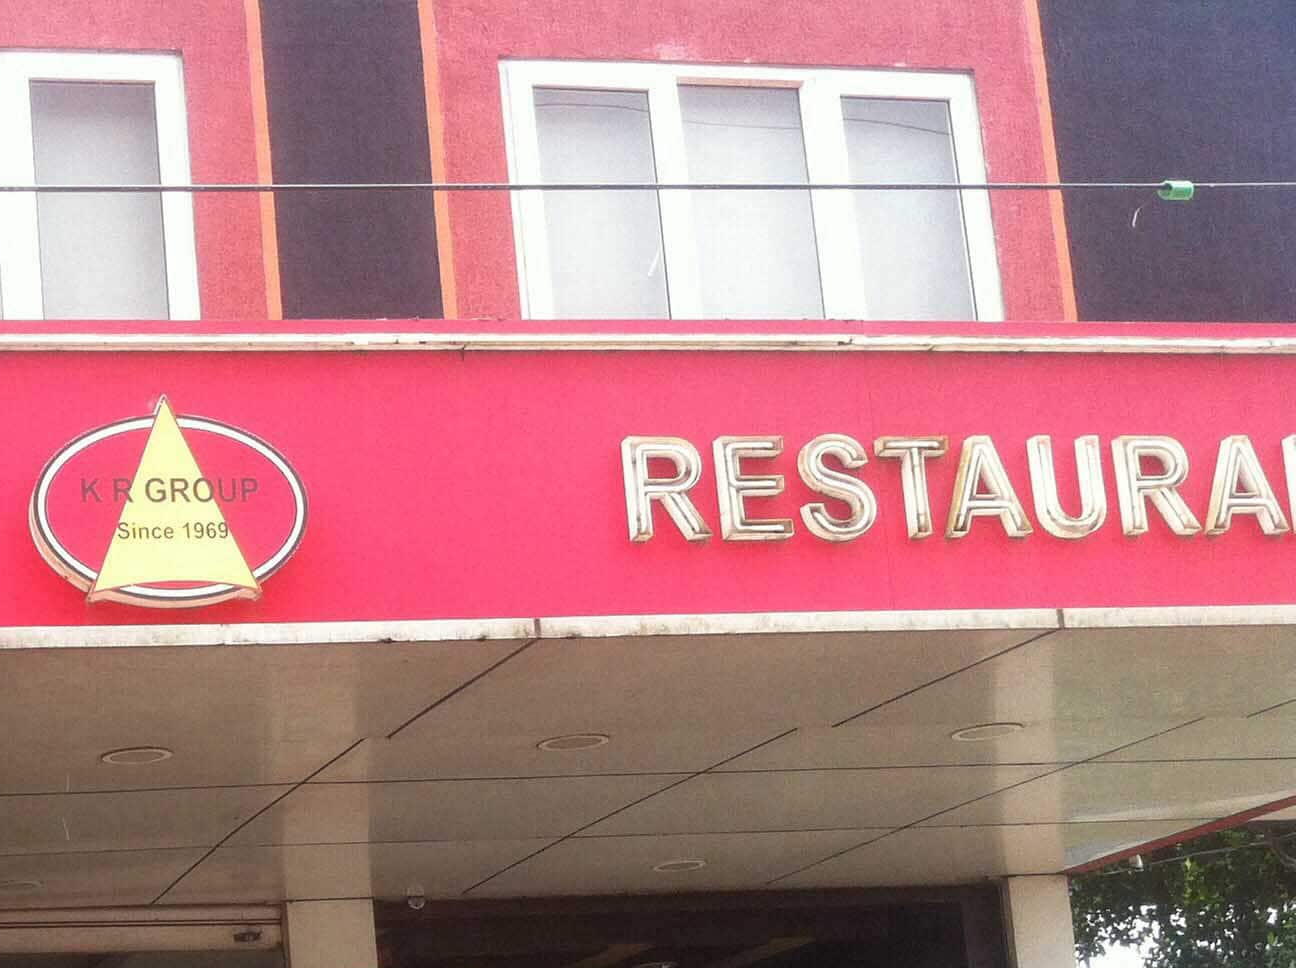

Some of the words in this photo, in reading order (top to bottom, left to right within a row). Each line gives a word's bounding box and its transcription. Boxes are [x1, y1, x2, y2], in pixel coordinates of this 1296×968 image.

[80, 478, 102, 502] K
[114, 478, 134, 502] R
[145, 478, 259, 502] GROUP
[621, 432, 1296, 543] RESTAURA
[117, 521, 175, 540] Since
[182, 521, 229, 540] 1969
